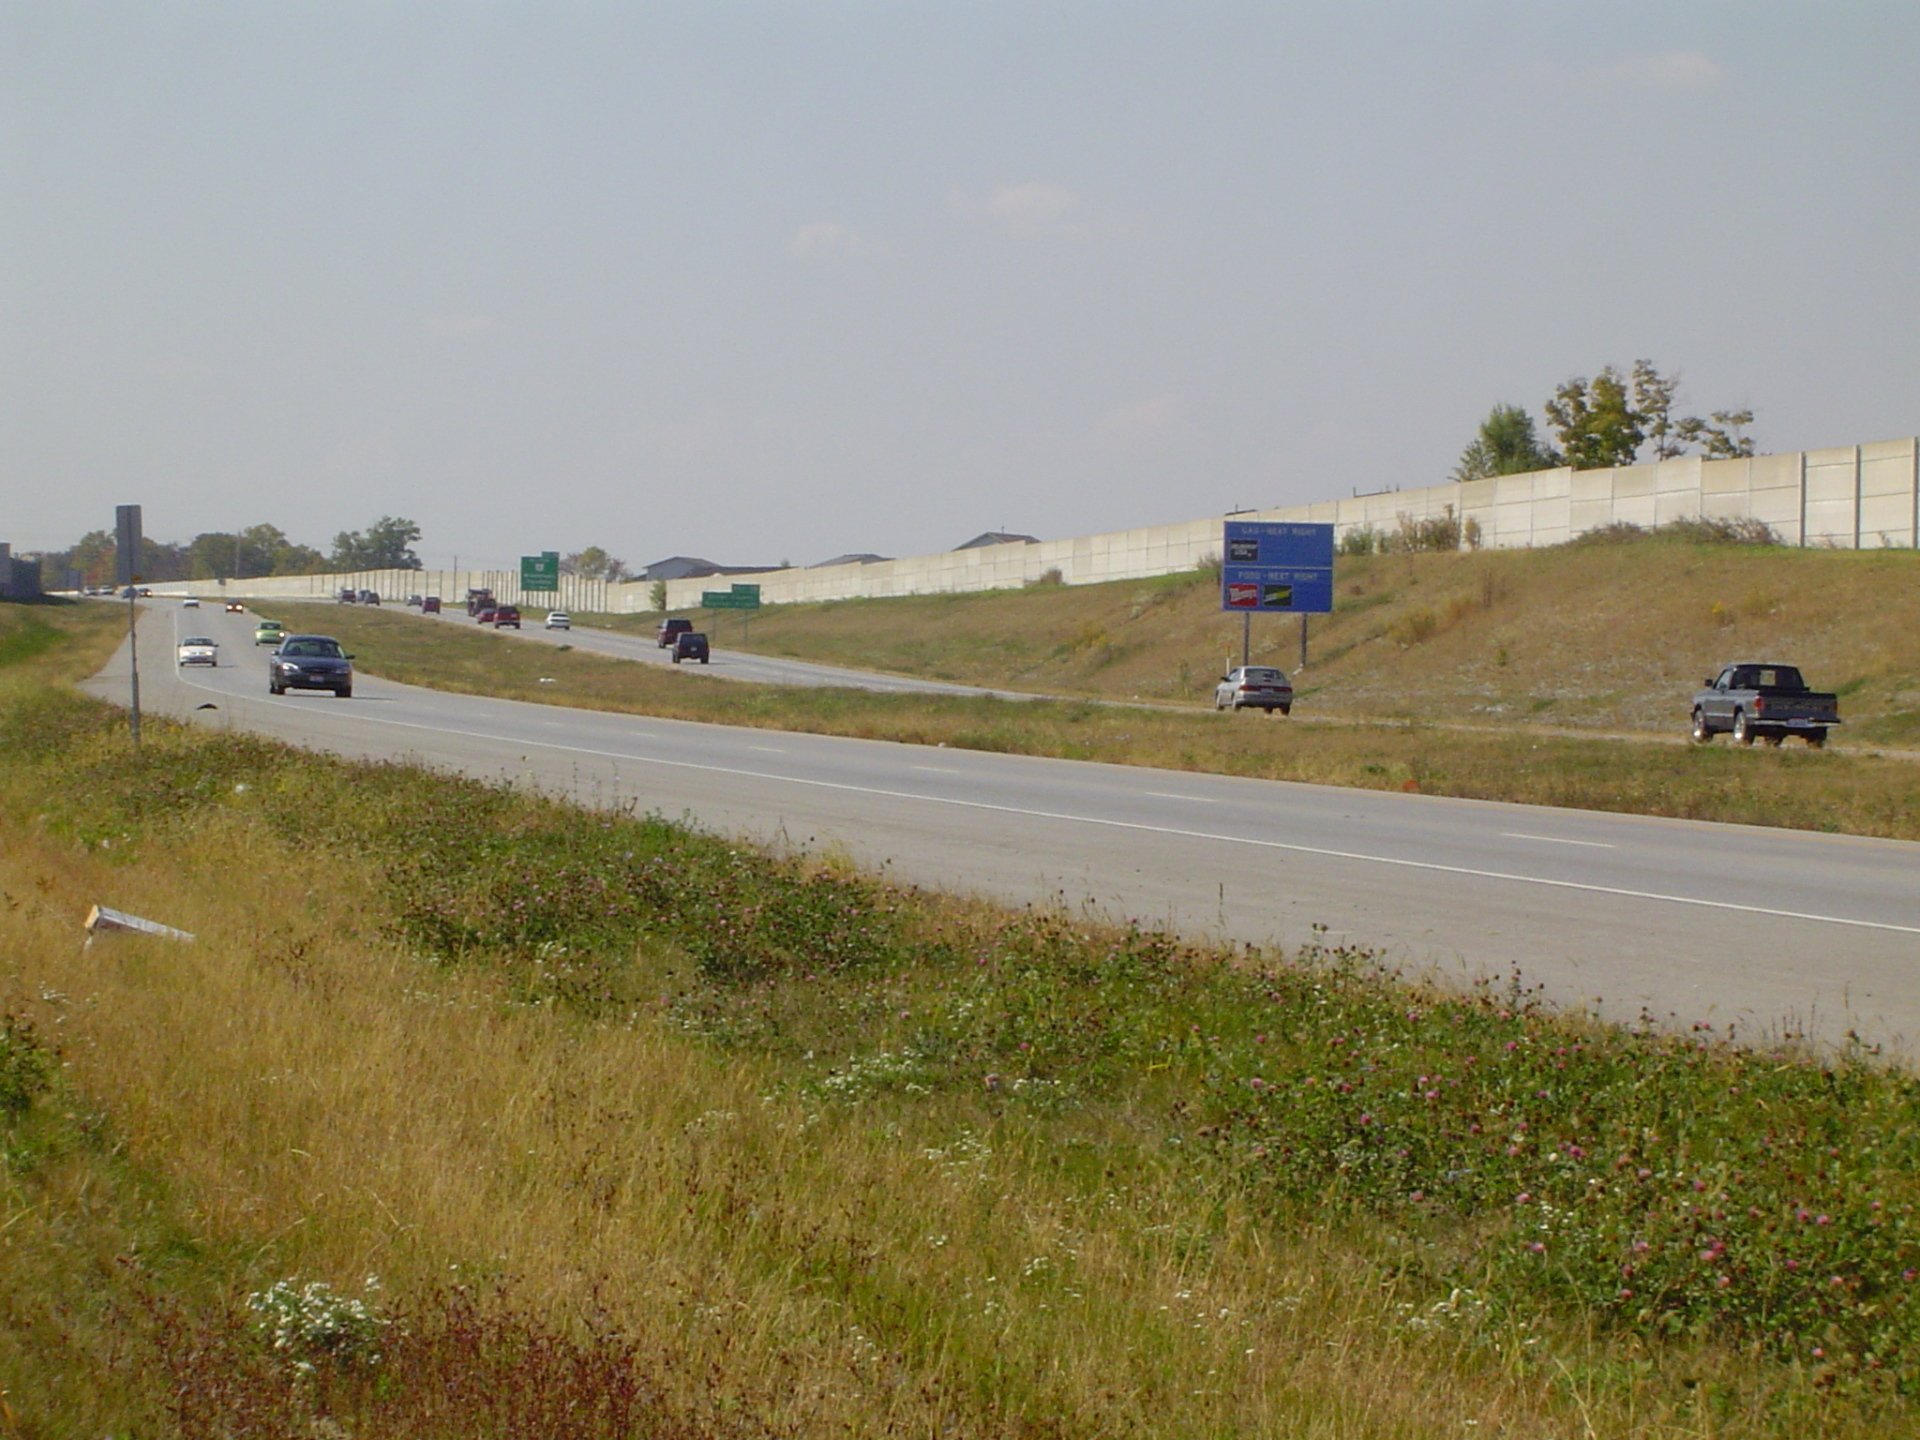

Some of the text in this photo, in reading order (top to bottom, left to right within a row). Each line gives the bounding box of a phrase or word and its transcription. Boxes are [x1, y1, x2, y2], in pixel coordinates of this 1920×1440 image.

[1264, 527, 1287, 535] NEXT
[1292, 527, 1317, 536] RIGHT
[1238, 571, 1261, 580] FOOD
[1267, 572, 1289, 581] NEXT
[1294, 572, 1318, 581] RIGHT
